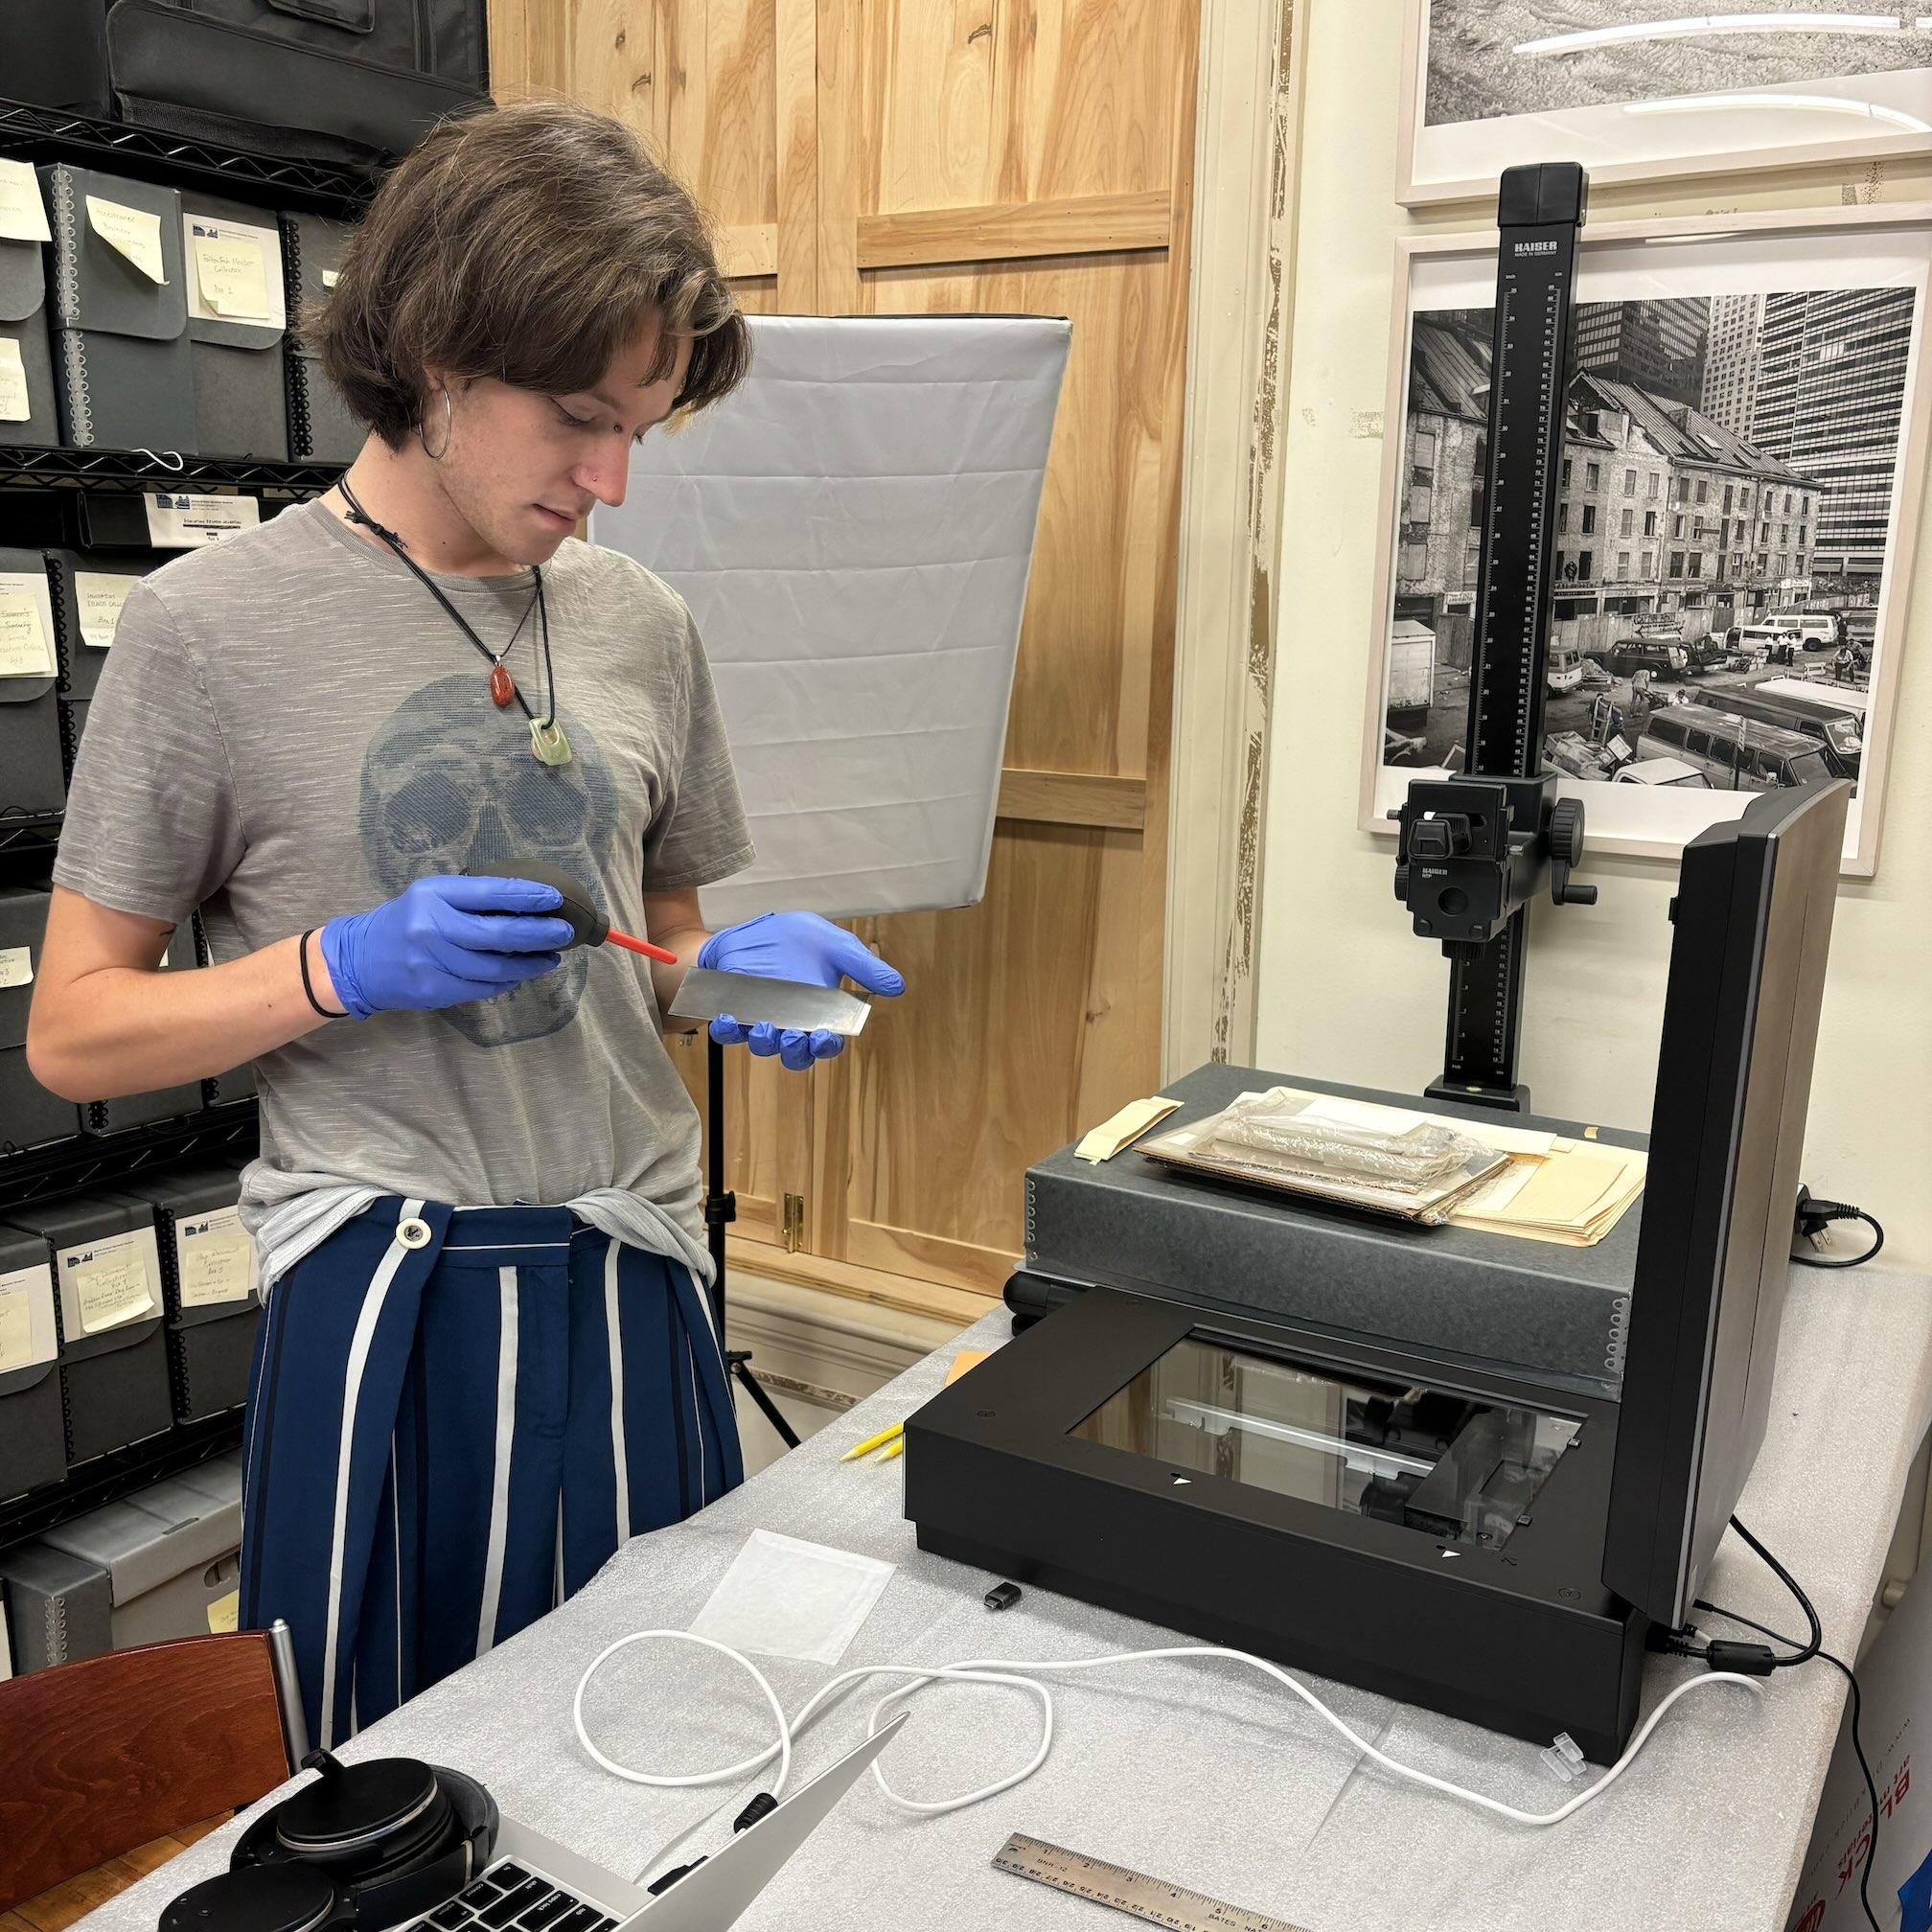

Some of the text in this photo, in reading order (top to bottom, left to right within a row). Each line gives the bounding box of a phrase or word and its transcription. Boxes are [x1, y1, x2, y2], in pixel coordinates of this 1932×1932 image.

[1514, 242, 1557, 252] KAISER
[1834, 1767, 1911, 1901] BLCK
[1838, 1785, 1892, 1869] mterials
[525, 1880, 537, 1889] shift
[537, 1894, 562, 1911] caps lock
[1208, 1913, 1236, 1926] BATES
